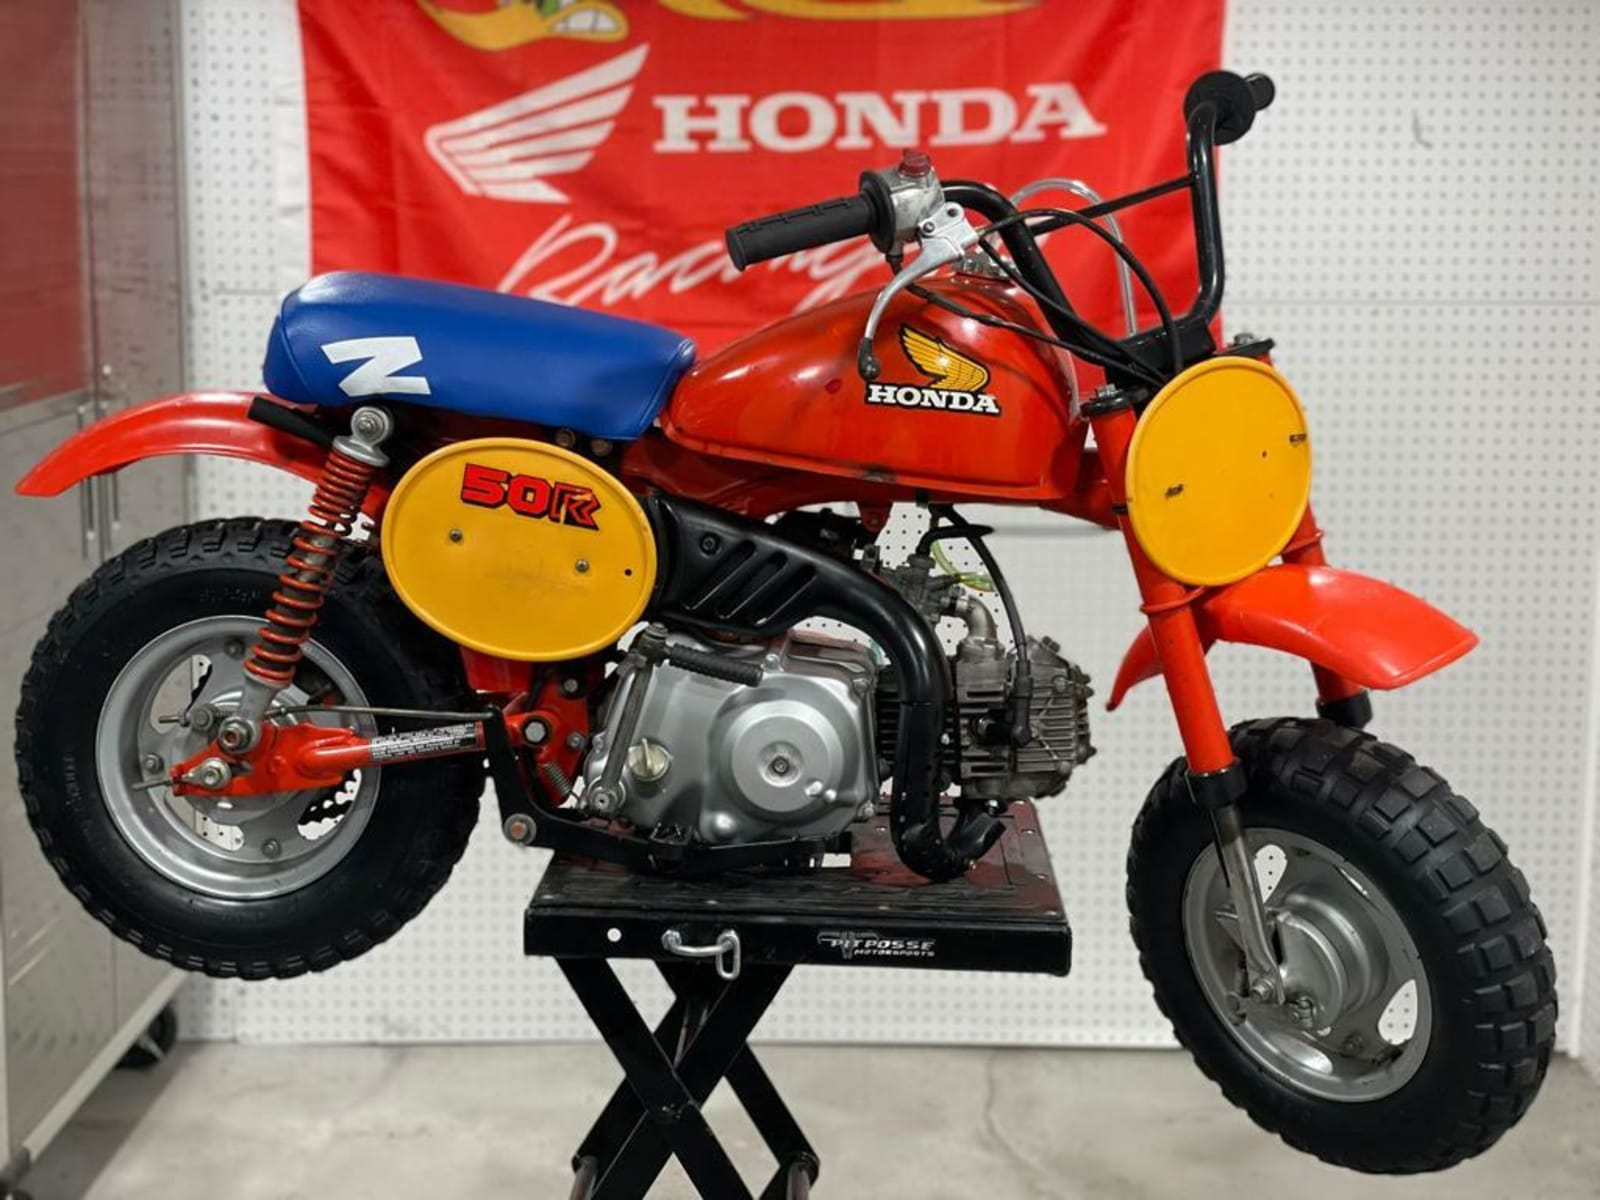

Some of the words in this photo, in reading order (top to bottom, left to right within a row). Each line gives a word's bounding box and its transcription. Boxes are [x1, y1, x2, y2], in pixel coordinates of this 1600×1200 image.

[653, 82, 1107, 154] HONDA
[867, 384, 1000, 413] HONDA
[461, 462, 601, 531] 50R
[864, 939, 936, 951] POSSE
